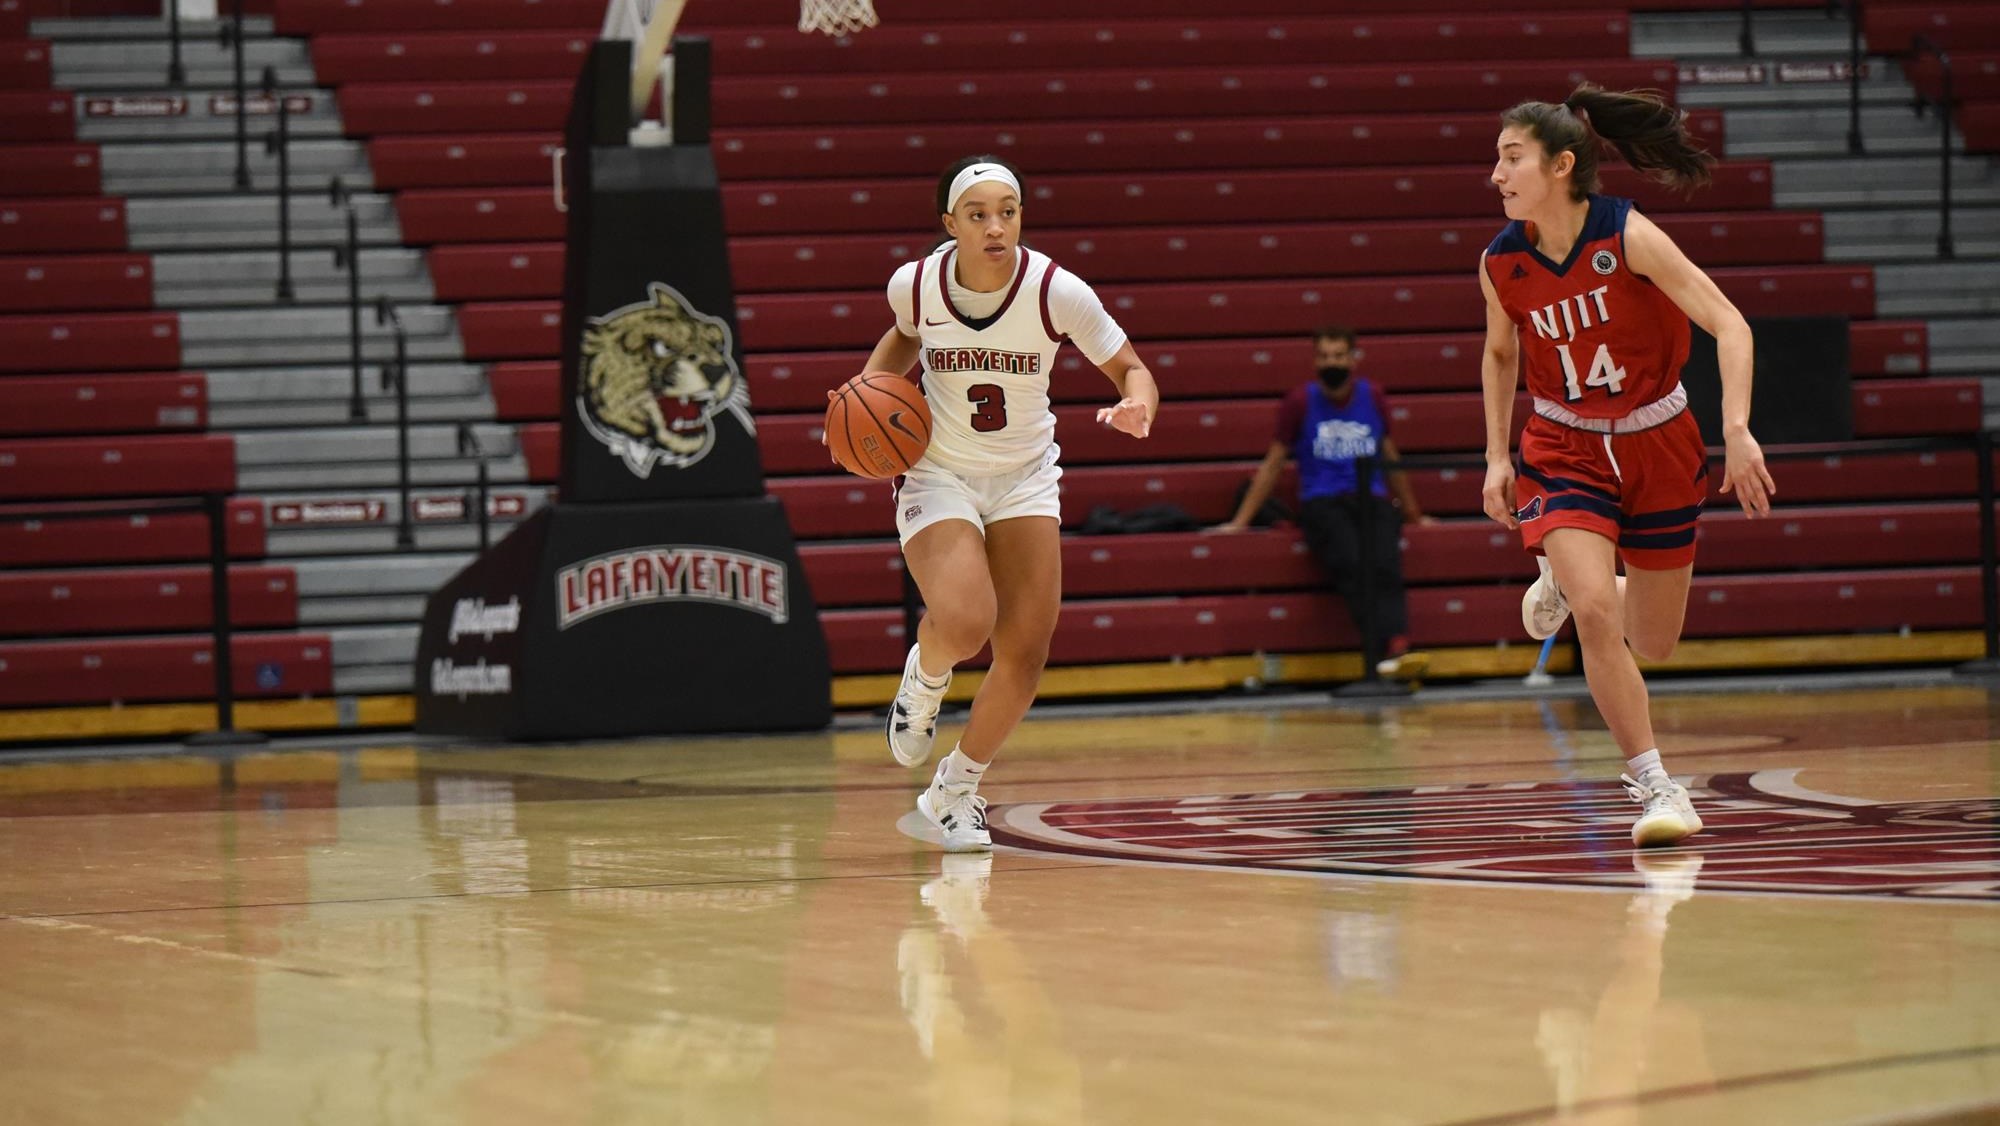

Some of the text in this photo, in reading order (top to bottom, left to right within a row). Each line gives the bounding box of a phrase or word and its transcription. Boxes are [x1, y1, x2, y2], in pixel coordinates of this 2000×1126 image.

[1530, 285, 1610, 342] NJIT
[926, 348, 1040, 375] LAFAYETTE
[1556, 343, 1627, 401] 14
[967, 383, 1008, 433] 3
[862, 433, 897, 475] ELITE
[557, 547, 787, 628] LAFAYETTE
